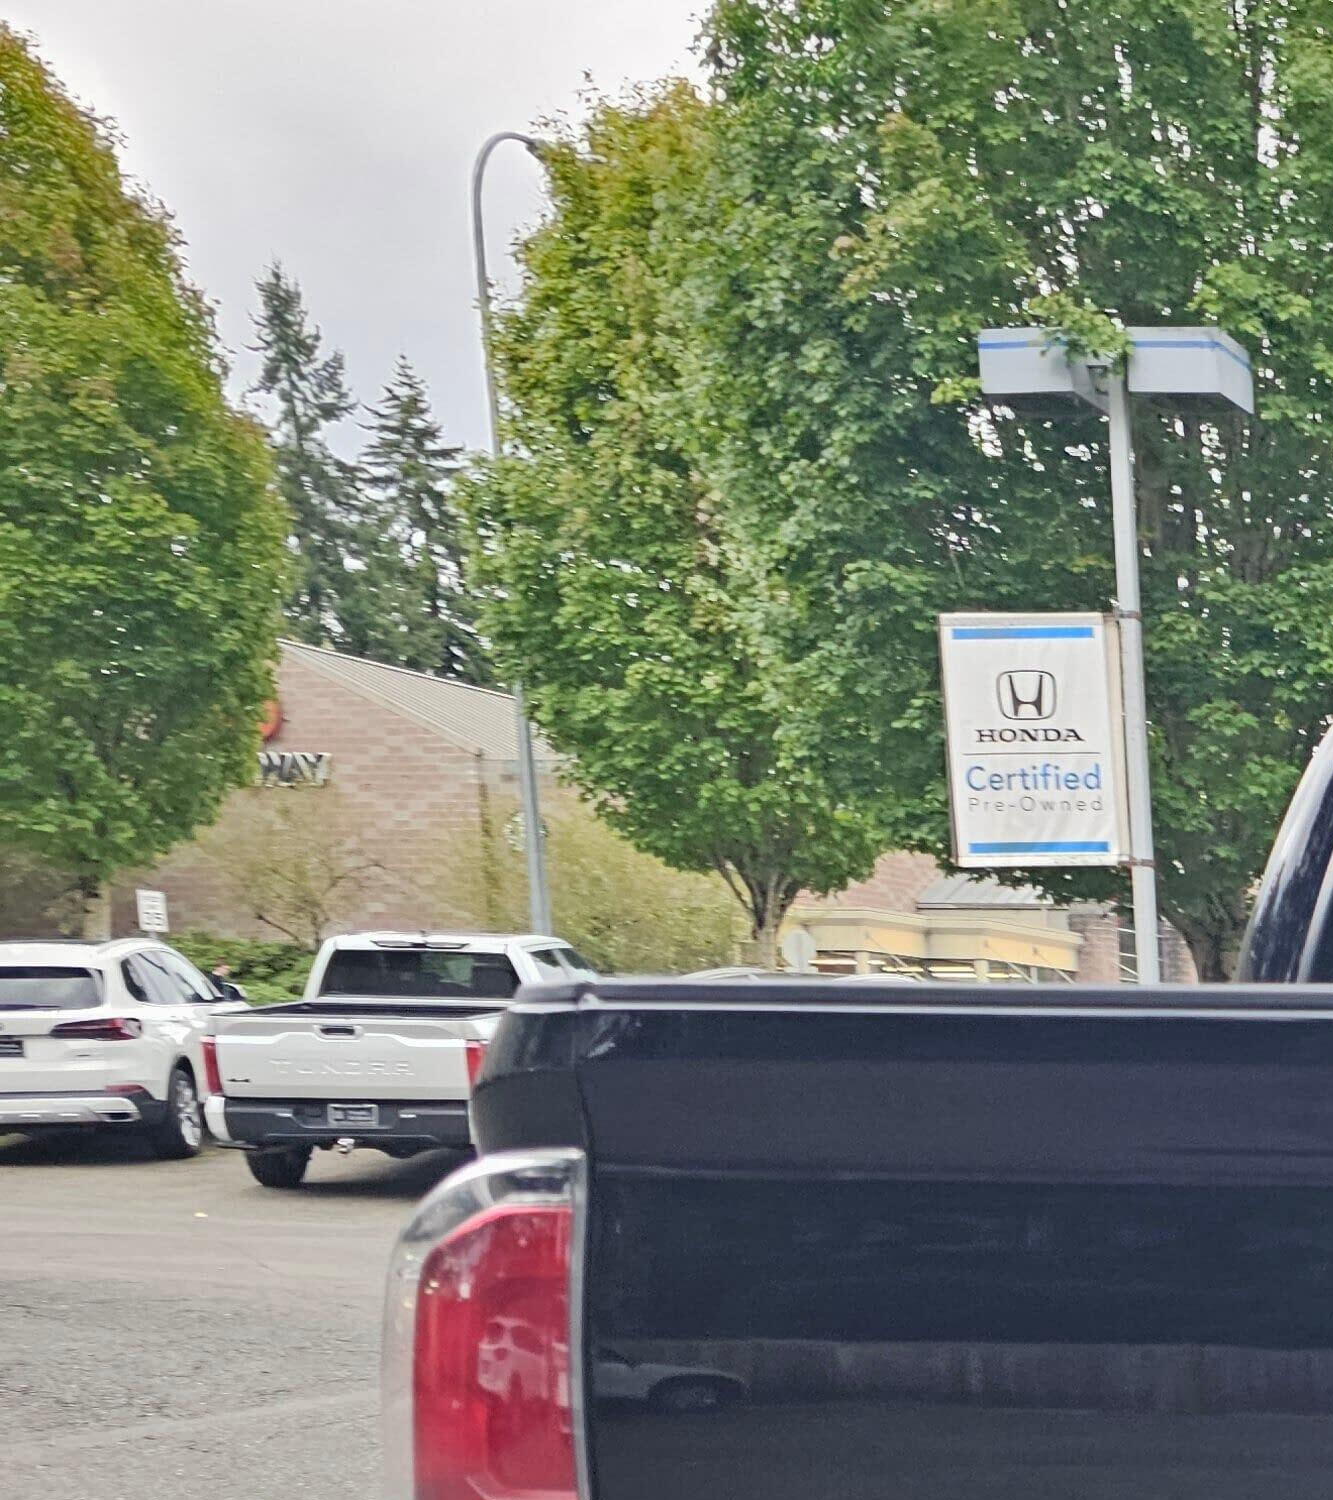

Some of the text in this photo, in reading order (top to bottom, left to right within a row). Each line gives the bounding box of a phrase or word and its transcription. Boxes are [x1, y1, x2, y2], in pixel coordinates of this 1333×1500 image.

[975, 728, 1086, 743] HONDA
[965, 762, 1101, 791] Certified
[968, 796, 1103, 812] Pre-Owned
